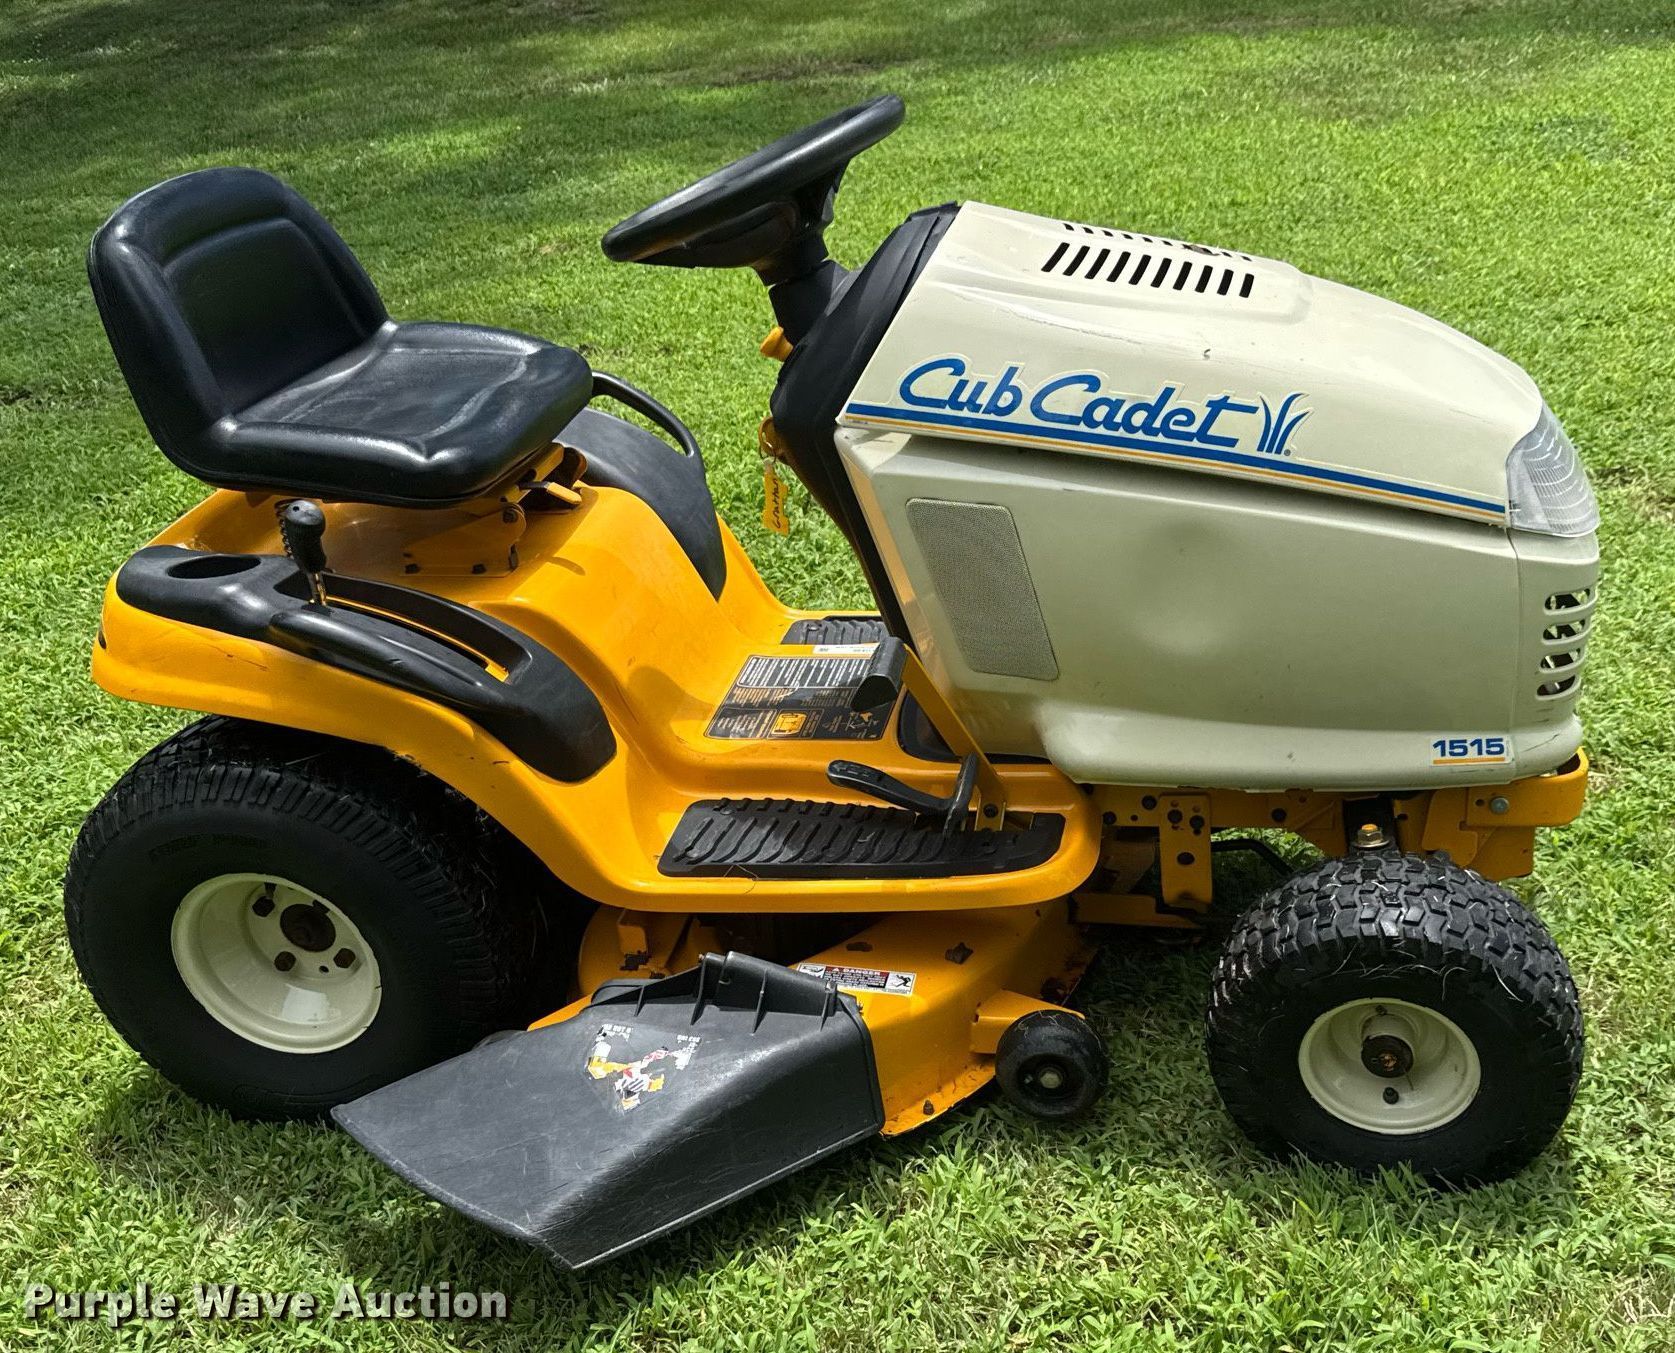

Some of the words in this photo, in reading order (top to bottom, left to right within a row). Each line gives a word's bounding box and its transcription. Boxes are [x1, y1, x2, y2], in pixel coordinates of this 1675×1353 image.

[899, 357, 1023, 417] Cub
[1029, 373, 1258, 448] Cadet
[1432, 738, 1505, 757] 1515
[842, 966, 881, 976] DANGER
